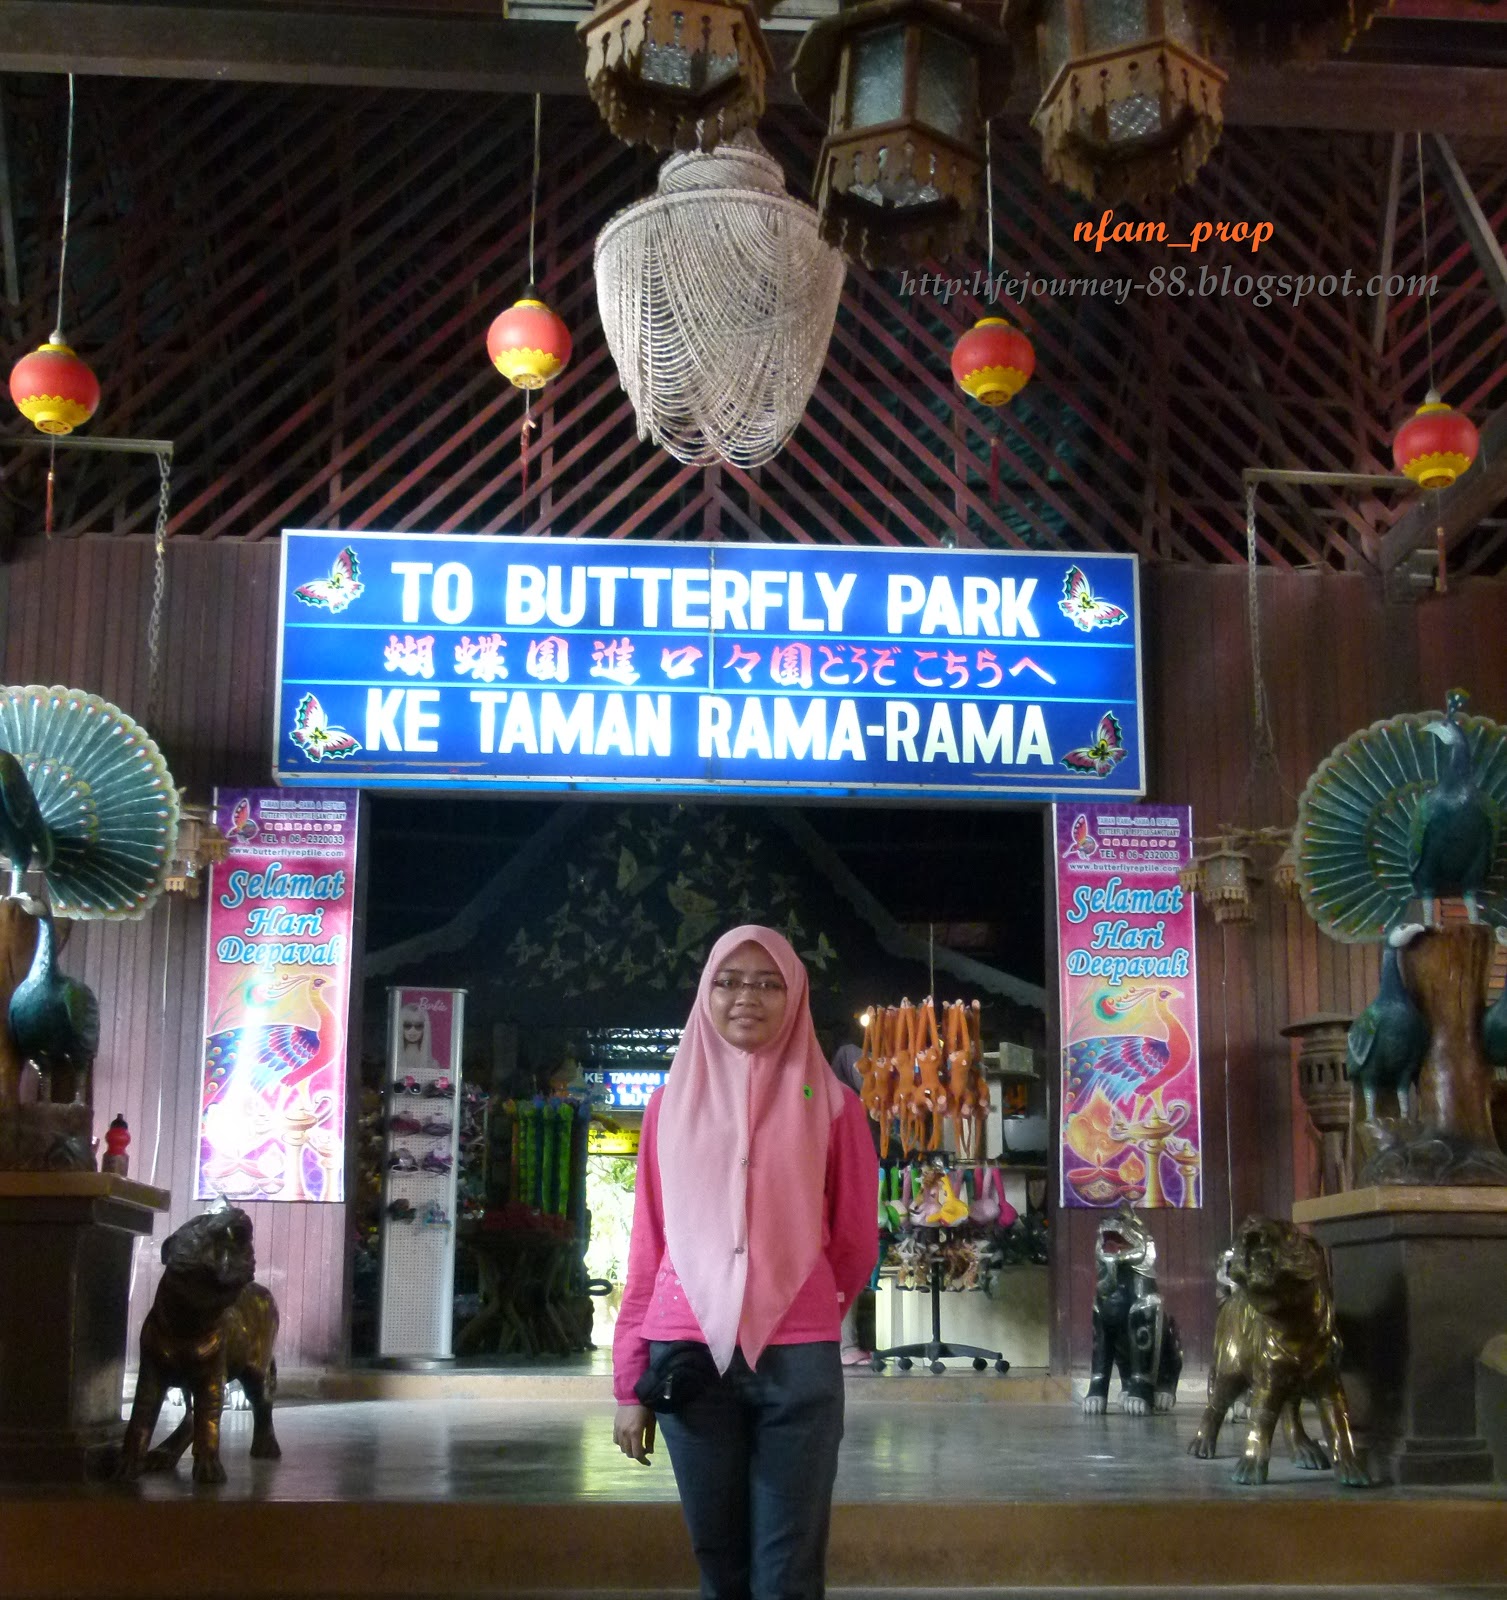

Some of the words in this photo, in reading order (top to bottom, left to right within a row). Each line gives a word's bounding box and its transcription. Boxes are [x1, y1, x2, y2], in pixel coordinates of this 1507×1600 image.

[391, 561, 473, 625] TO
[506, 564, 857, 632] BUTTERFLY
[887, 574, 1040, 638] PARK
[365, 688, 440, 752] KE
[470, 690, 671, 756] TAMAN
[698, 697, 1054, 765] RAMA-RAMA
[260, 833, 278, 844] TEL
[1099, 849, 1116, 859] TEL
[1069, 863, 1180, 873] www.butterflyreptile.com
[220, 862, 346, 909] Selamat
[1067, 877, 1183, 924] Selamat
[244, 906, 325, 937] Hari
[1091, 919, 1165, 949] Hari
[217, 935, 347, 972] Deepavali
[1067, 948, 1189, 986] Deepavali
[418, 997, 448, 1011] Barbie
[585, 1073, 604, 1083] KE
[609, 1072, 660, 1085] TAMAN
